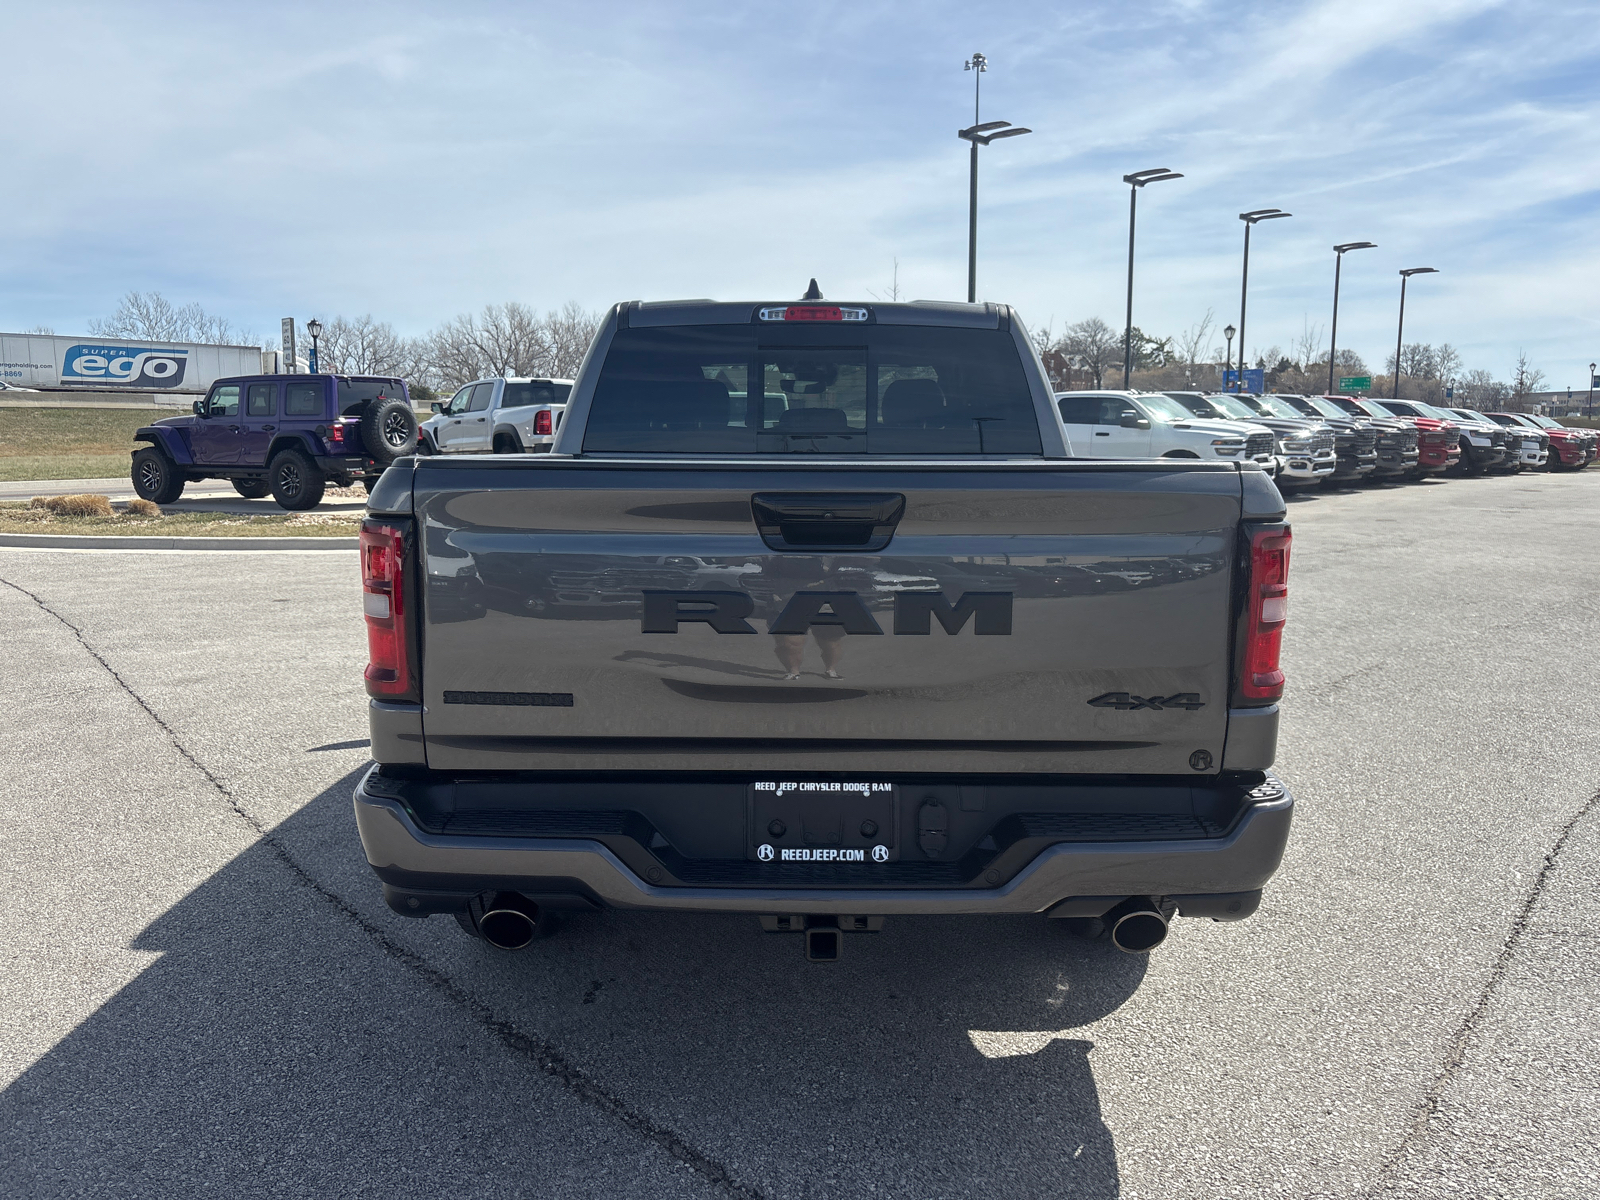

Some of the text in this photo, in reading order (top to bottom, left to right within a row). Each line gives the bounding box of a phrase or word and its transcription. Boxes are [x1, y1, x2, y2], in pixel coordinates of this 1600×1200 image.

[82, 348, 127, 356] SUPER
[71, 353, 180, 381] ego
[641, 590, 1013, 636] RAM
[755, 782, 892, 792] REED JEEP CHRYSLER DODGE RAM
[781, 849, 865, 861] REEDJEEP.COM
